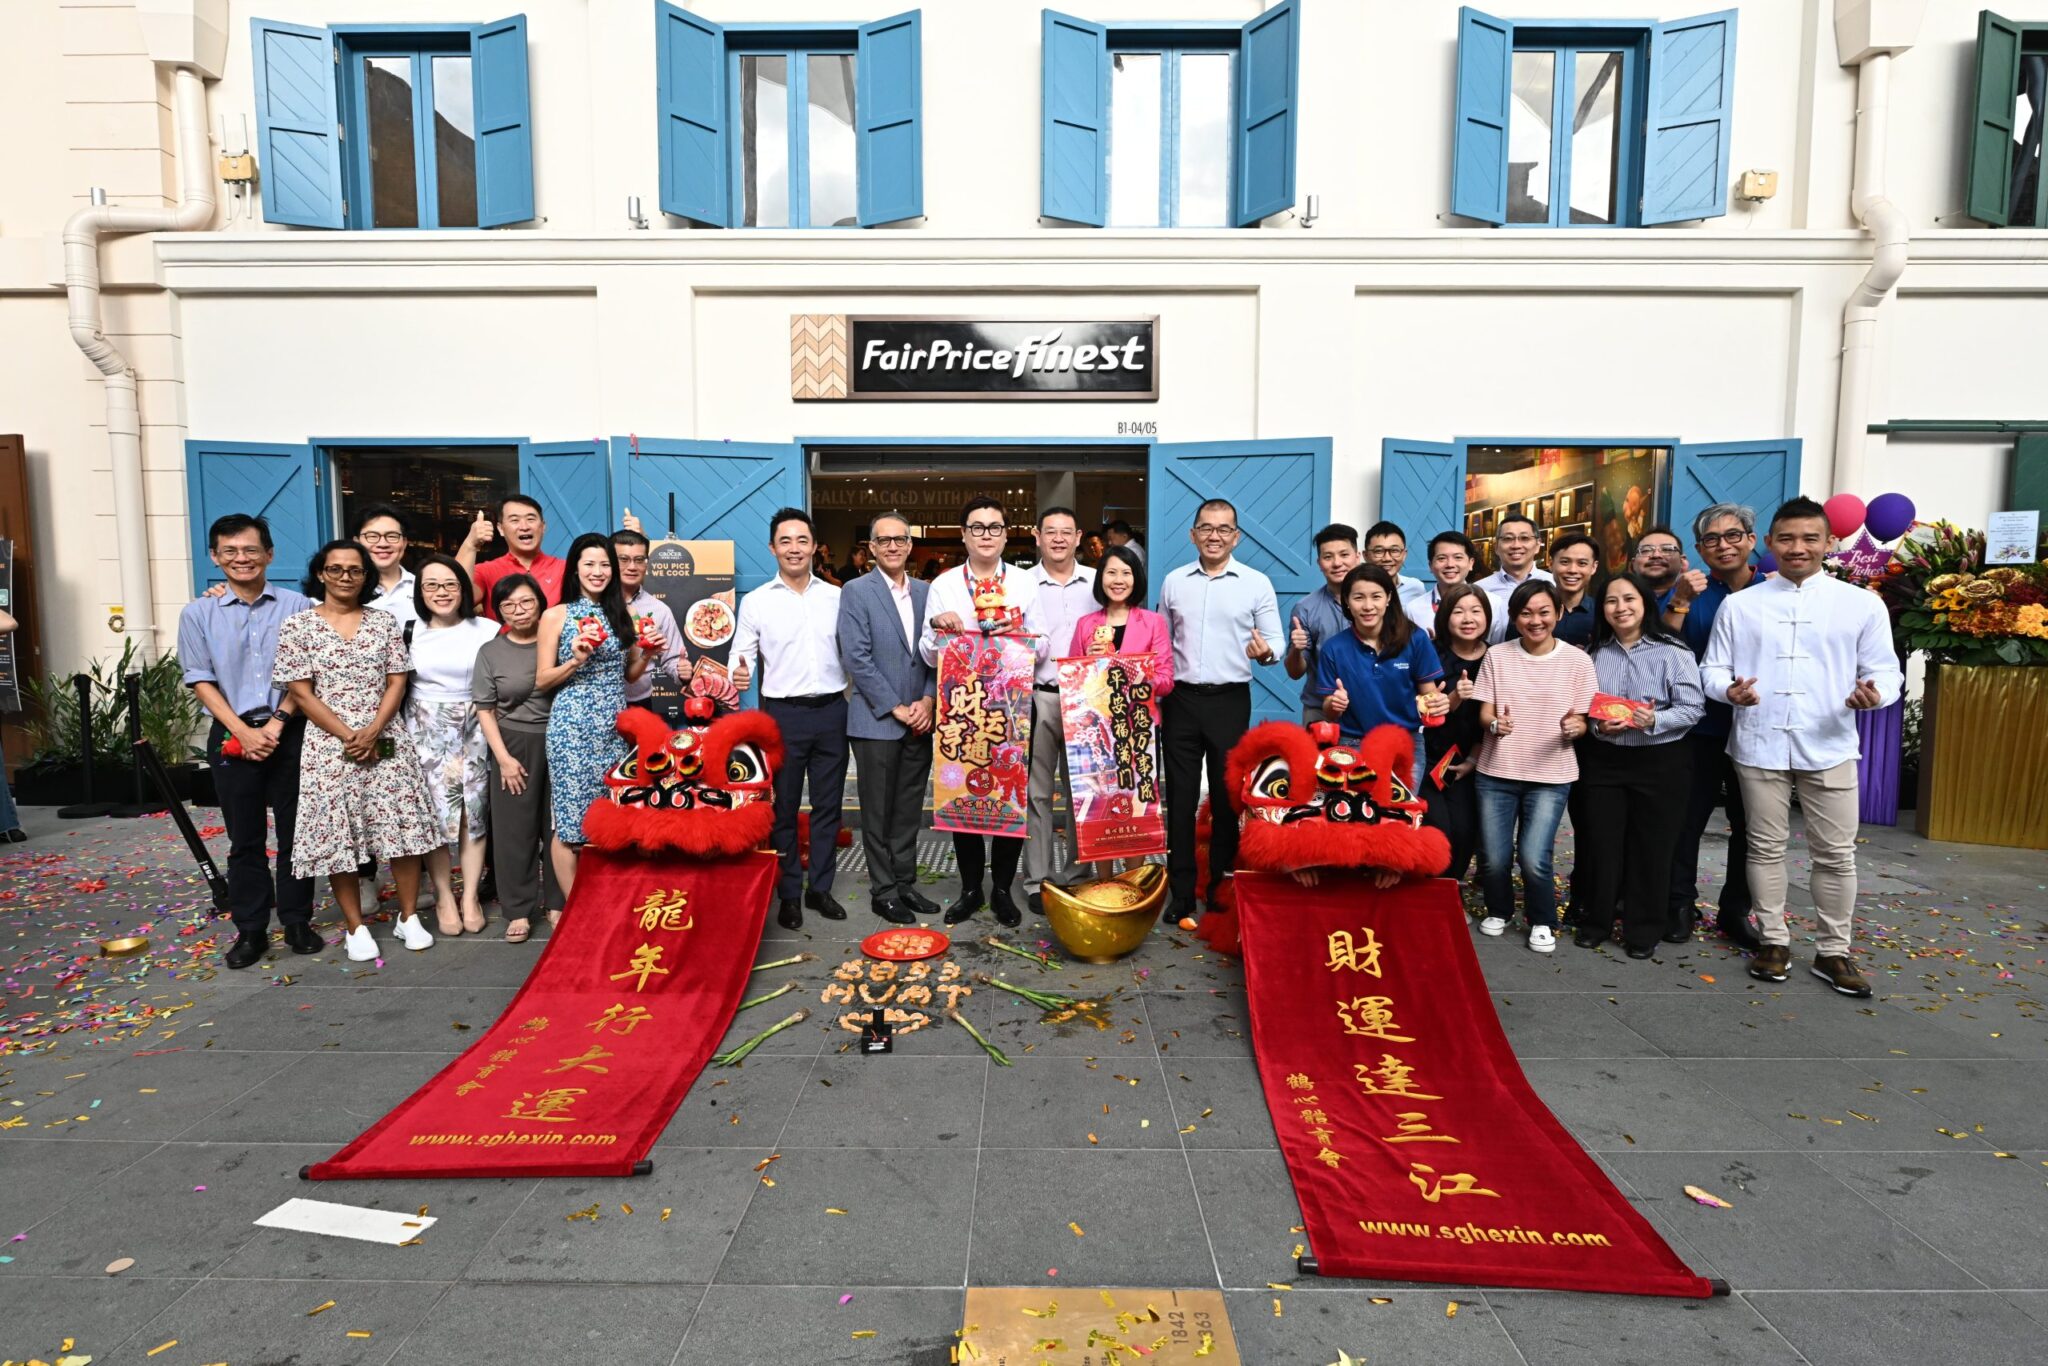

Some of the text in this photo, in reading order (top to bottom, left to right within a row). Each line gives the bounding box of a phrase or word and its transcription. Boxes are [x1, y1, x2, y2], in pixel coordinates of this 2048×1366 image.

[862, 327, 1146, 379] FairPrice finest
[1117, 421, 1158, 435] B1-04/05
[860, 489, 918, 505] PACKED
[924, 489, 961, 505] WITH
[651, 562, 690, 570] YOU PICK
[1848, 550, 1879, 567] Best
[1107, 667, 1135, 790] 平安福满门
[1129, 683, 1156, 803] 心想万事成
[501, 889, 693, 1123] 龍年行大運
[821, 983, 973, 1010] HUAT
[1324, 927, 1502, 1203] 財運達三江
[409, 1130, 617, 1147] www.sghexin.com
[1358, 1219, 1613, 1248] www.sghexin.com
[1168, 1311, 1189, 1345] 1842
